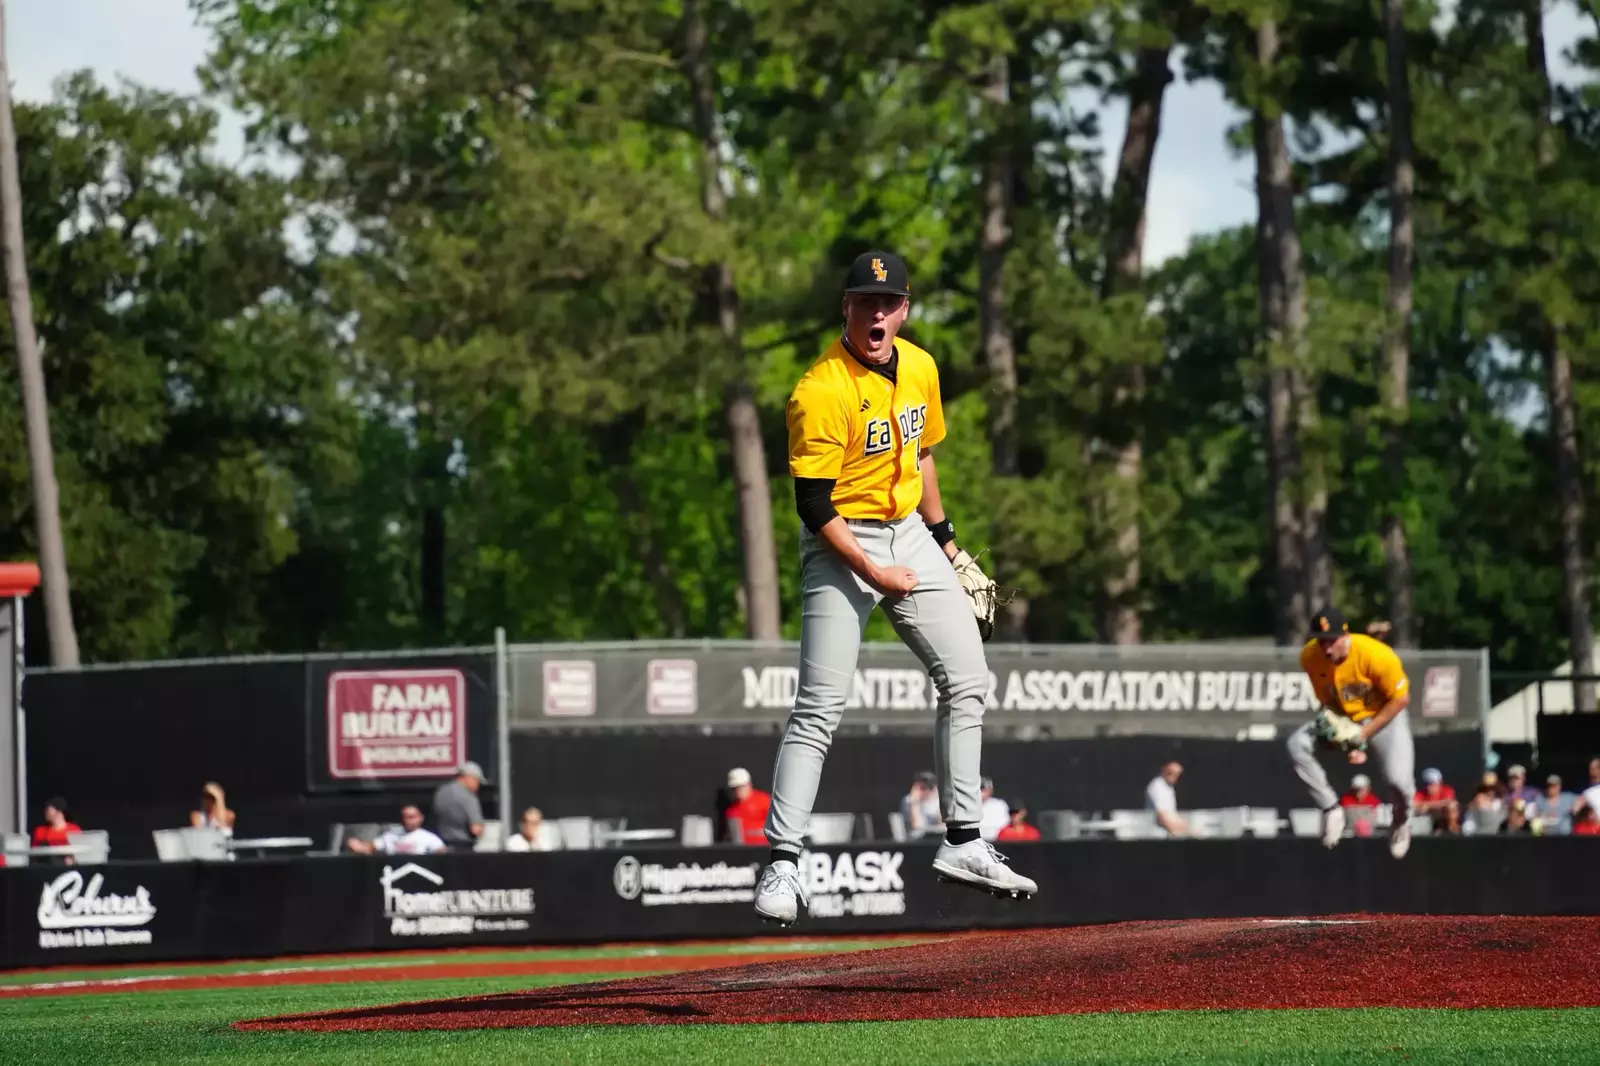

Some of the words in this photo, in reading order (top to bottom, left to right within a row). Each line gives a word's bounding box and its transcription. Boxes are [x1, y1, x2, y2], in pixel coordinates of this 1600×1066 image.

[864, 404, 927, 455] Eagles
[371, 683, 452, 711] FARM
[1003, 670, 1195, 711] ASSOCIATION
[1198, 671, 1321, 712] BULLPEN
[342, 710, 454, 738] BUREAU
[810, 850, 905, 893] BASK
